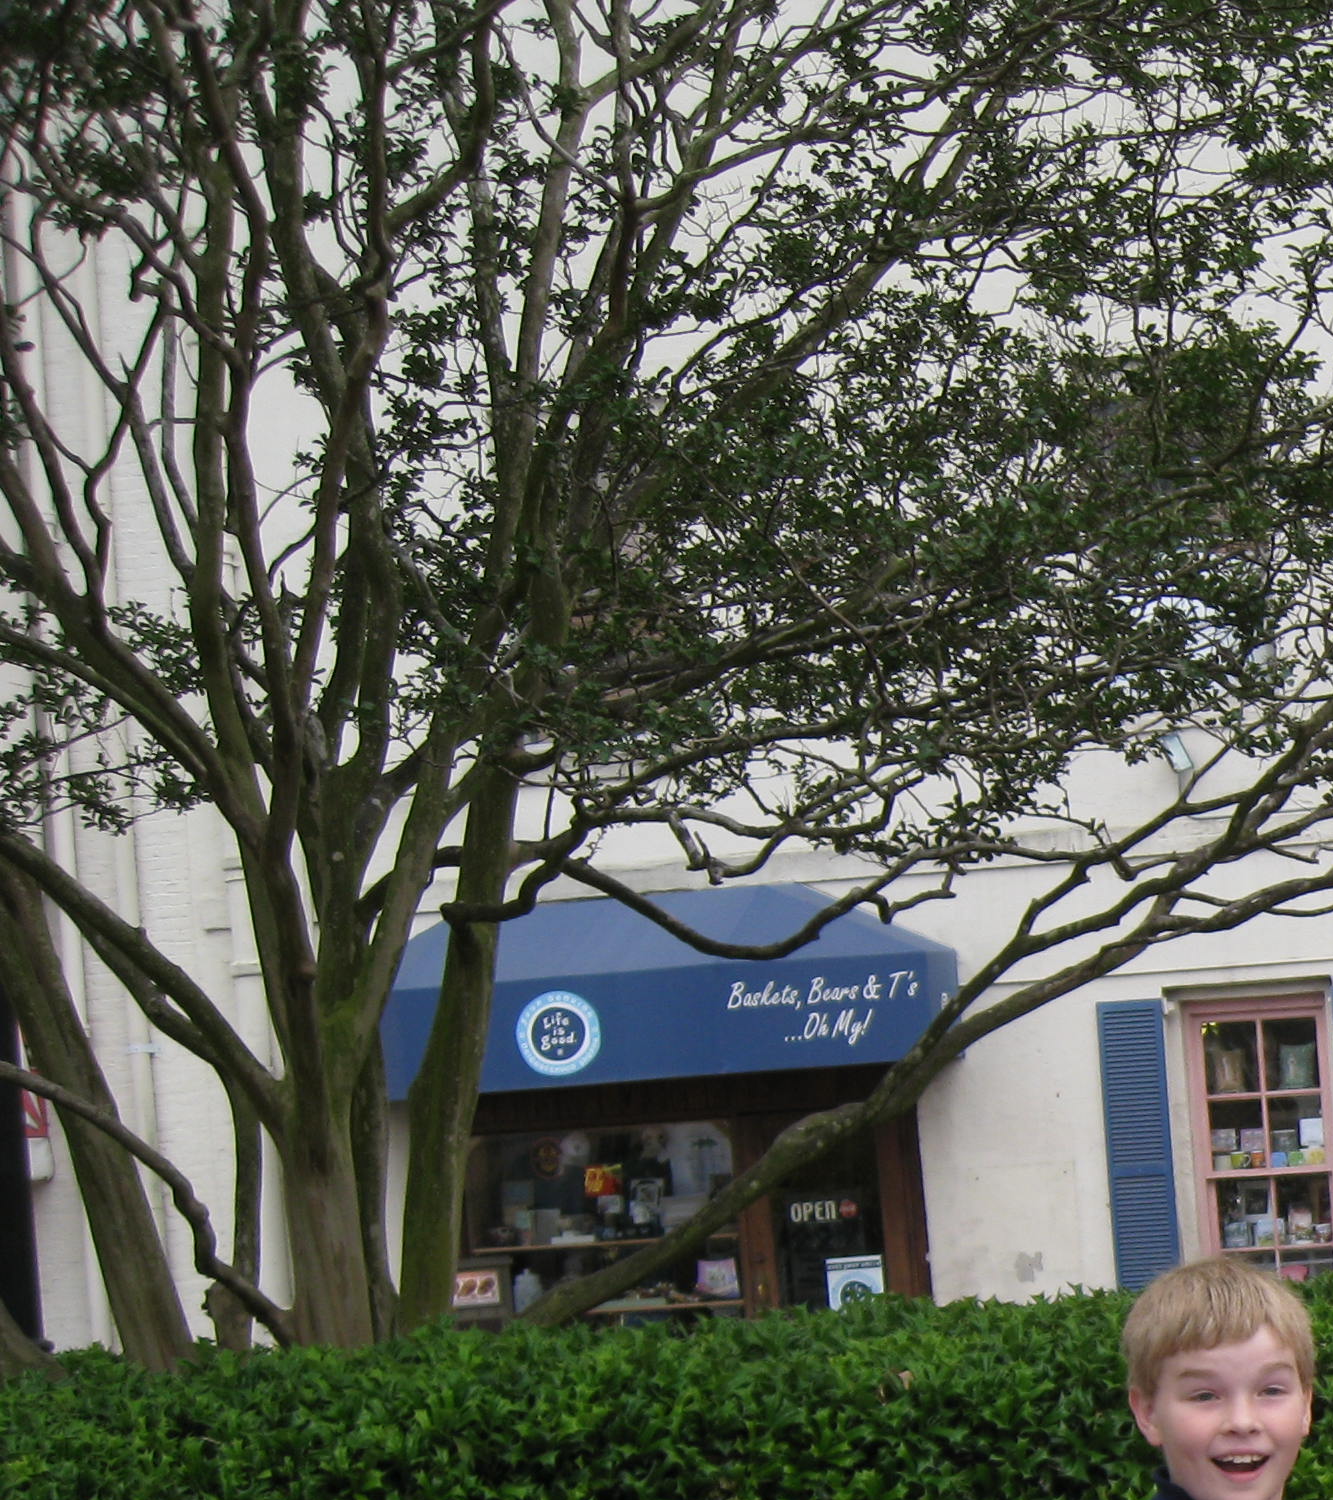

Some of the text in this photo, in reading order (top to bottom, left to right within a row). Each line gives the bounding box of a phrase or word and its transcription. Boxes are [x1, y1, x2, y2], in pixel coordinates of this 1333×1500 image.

[727, 970, 919, 1010] Baskets, Bears & T's
[543, 1011, 569, 1029] Life
[553, 1026, 565, 1036] is
[832, 1008, 874, 1045] My!
[790, 1200, 837, 1222] OPEN
